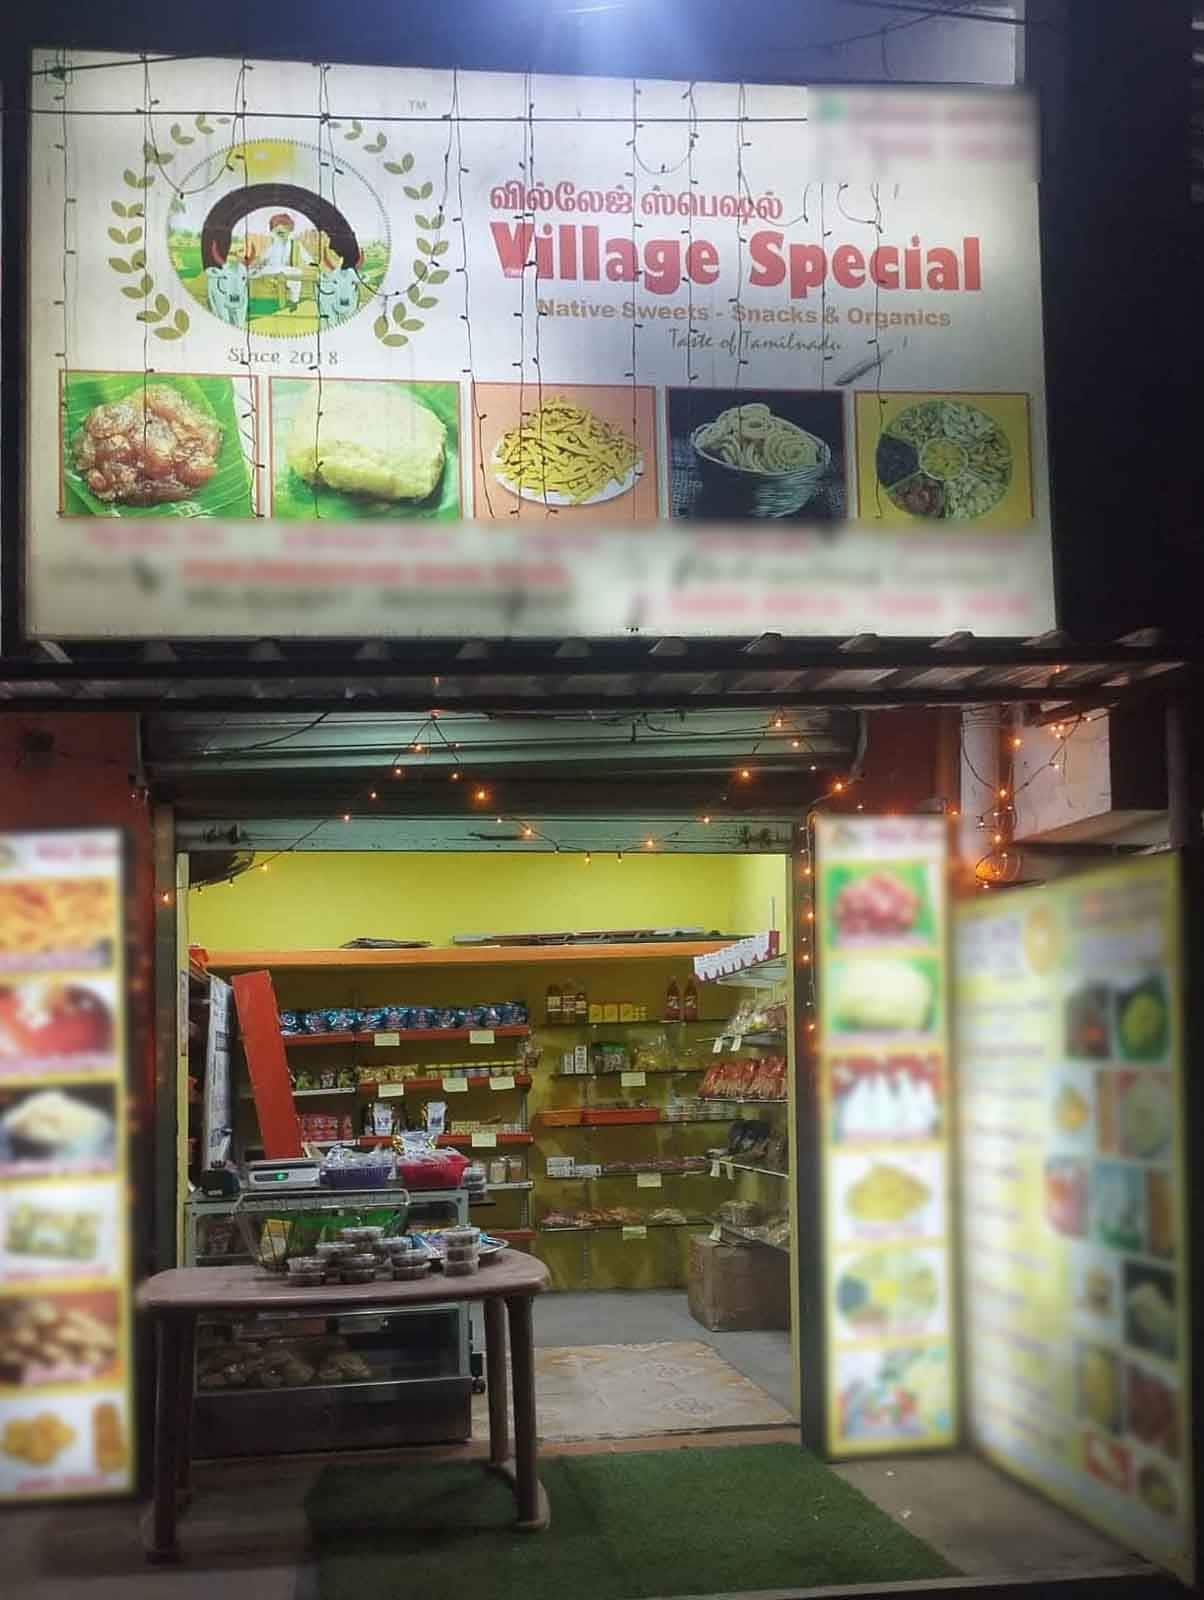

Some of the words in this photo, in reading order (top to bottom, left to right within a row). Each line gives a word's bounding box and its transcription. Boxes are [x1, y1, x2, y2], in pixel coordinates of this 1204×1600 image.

[408, 99, 428, 112] TM
[489, 222, 720, 295] Village
[748, 230, 983, 299] Special
[537, 299, 616, 319] Native
[621, 301, 709, 321] Sweets
[731, 304, 818, 324] Snacks
[820, 304, 840, 324] &
[847, 306, 951, 329] Organics
[227, 347, 280, 363] Since
